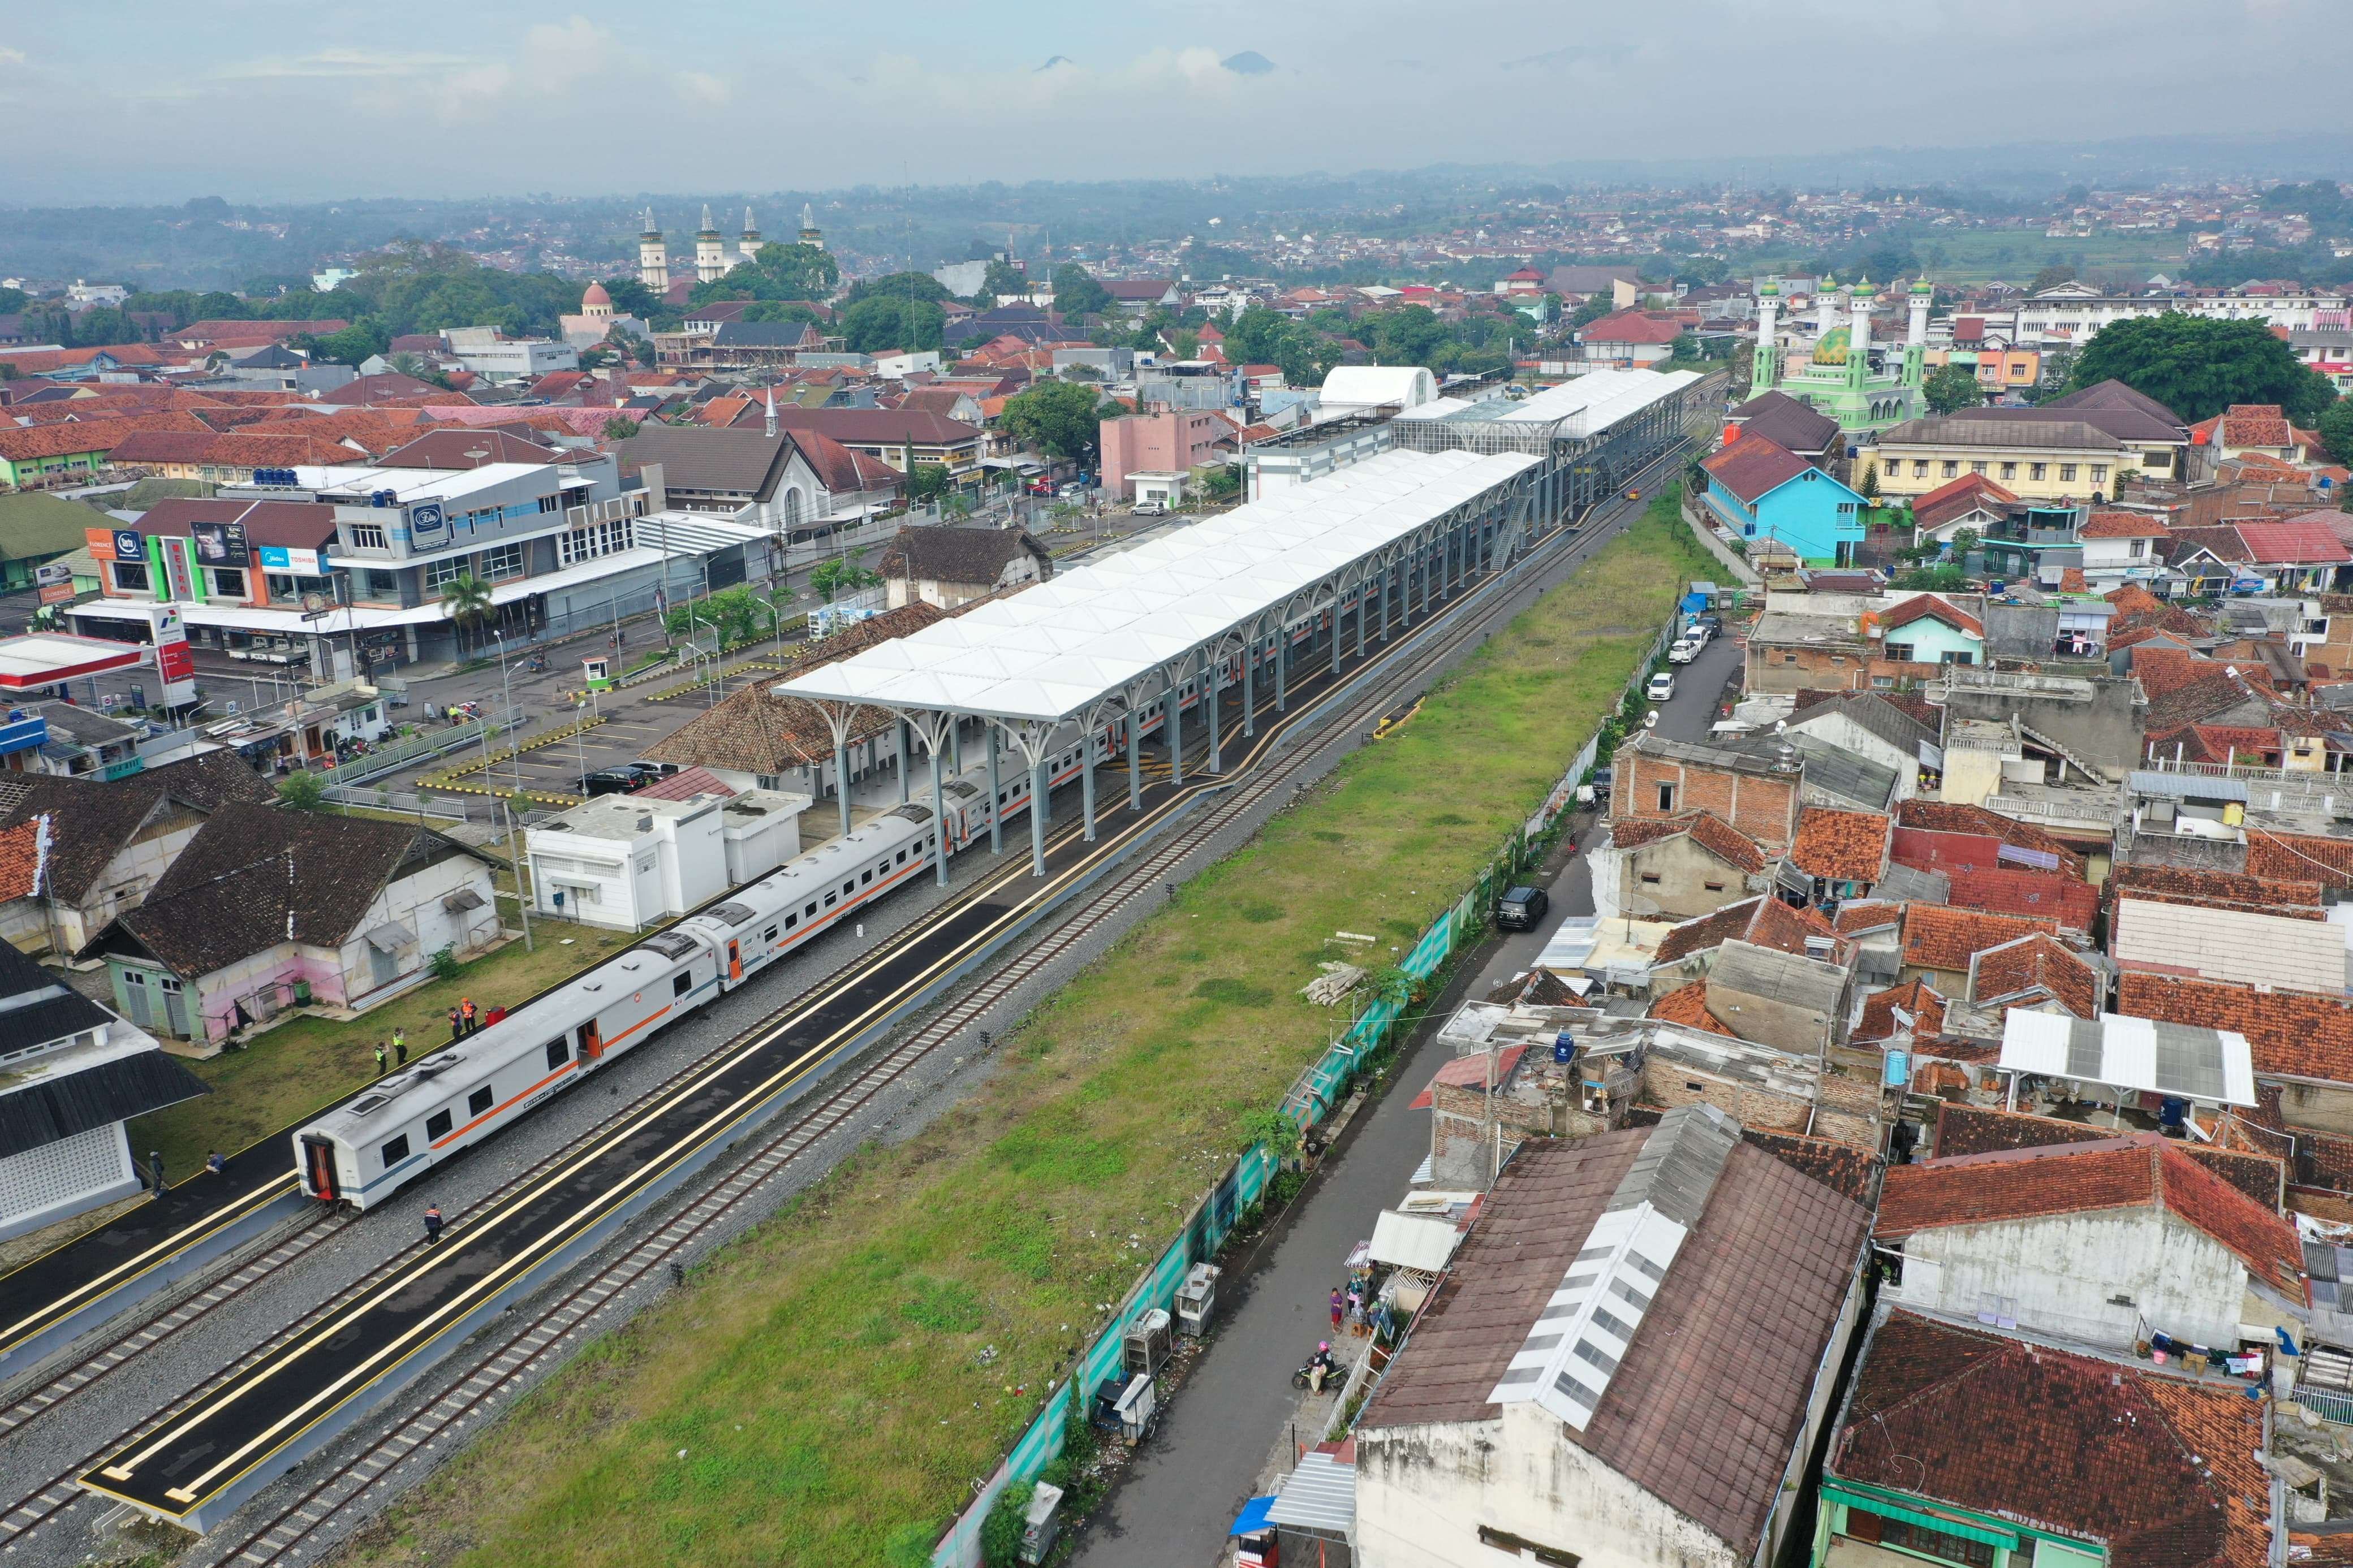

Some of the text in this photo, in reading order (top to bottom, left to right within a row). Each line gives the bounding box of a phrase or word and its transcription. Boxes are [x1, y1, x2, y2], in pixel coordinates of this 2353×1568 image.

[419, 511, 437, 524] Elite
[121, 538, 133, 548] Serta
[172, 544, 188, 594] METRO
[45, 588, 71, 598] FLORENCE
